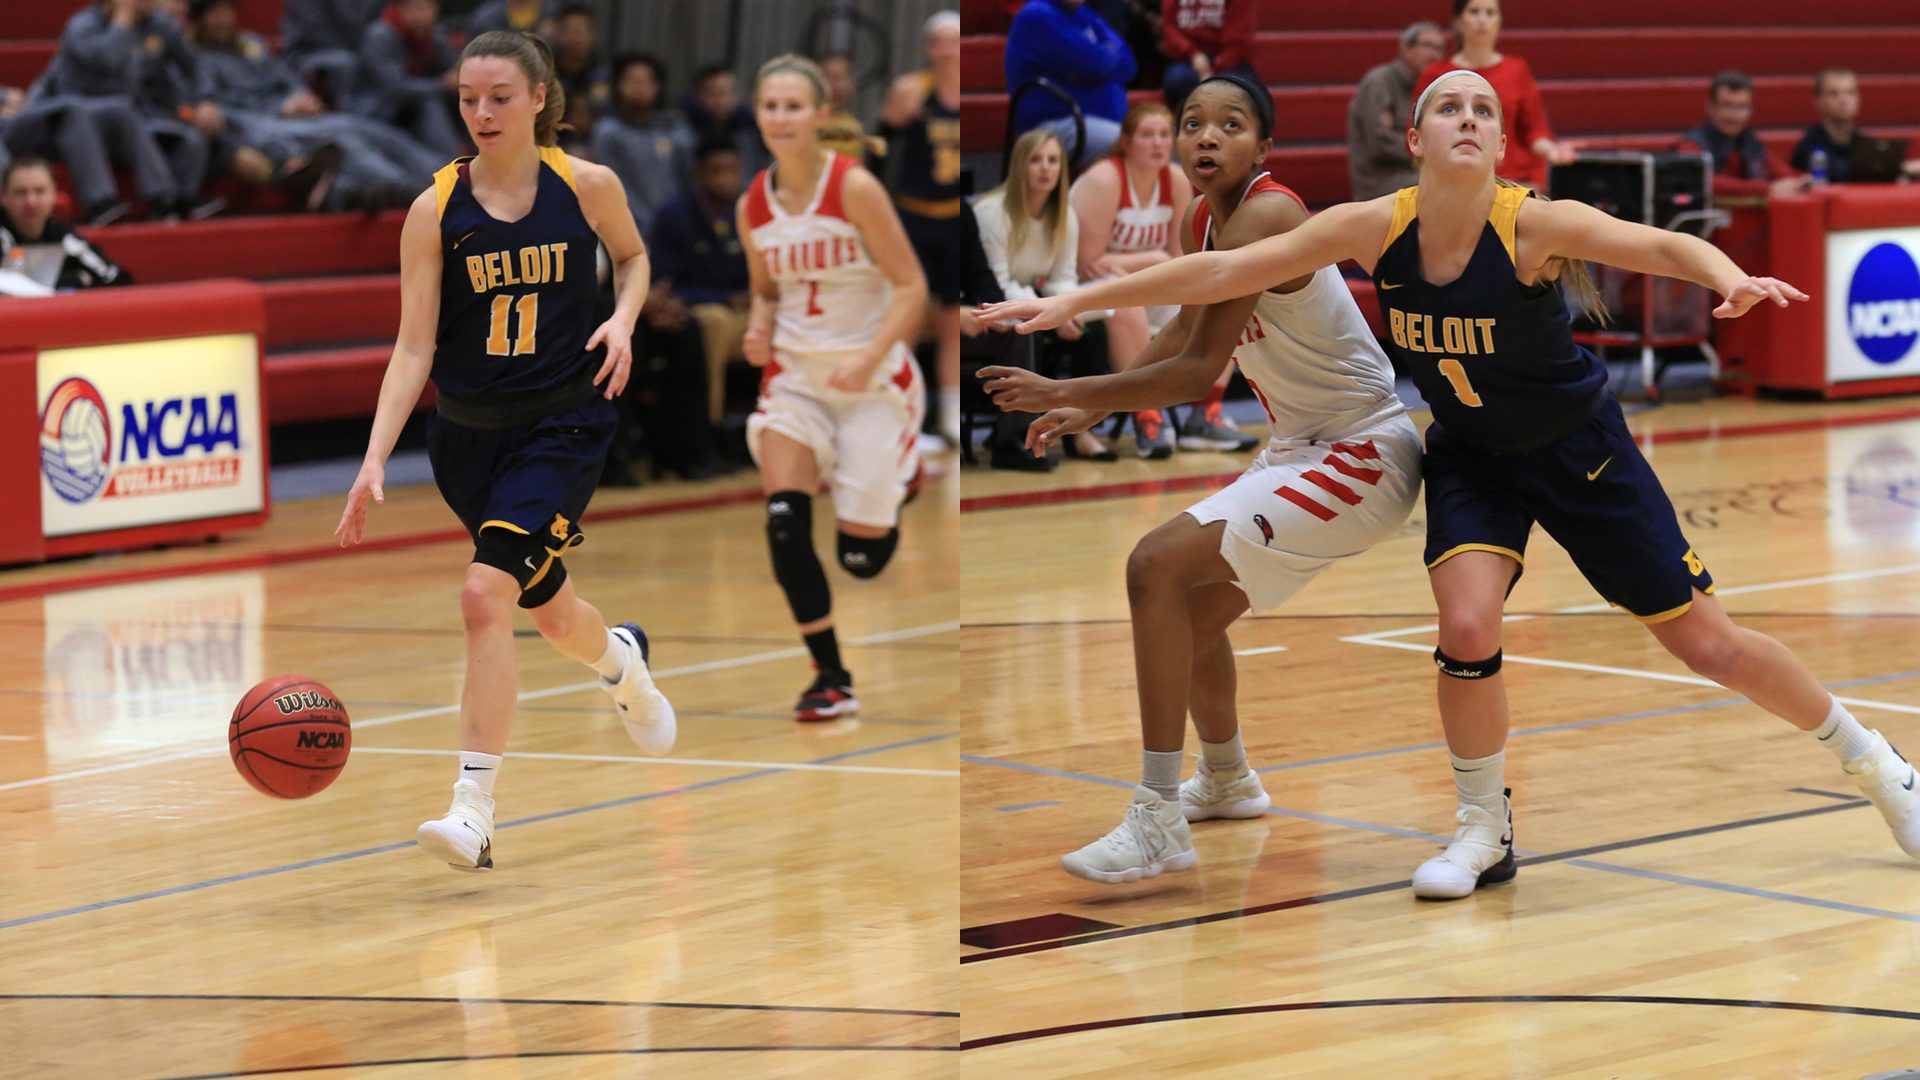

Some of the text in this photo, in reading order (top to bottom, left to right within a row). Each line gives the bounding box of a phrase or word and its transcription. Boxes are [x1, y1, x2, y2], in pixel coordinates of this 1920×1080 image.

[466, 242, 568, 293] BELOIT
[486, 292, 539, 356] 11
[1389, 307, 1496, 355] BELOIT
[1437, 358, 1484, 408] 1
[120, 394, 239, 462] NCAA
[296, 731, 345, 749] NCAA
